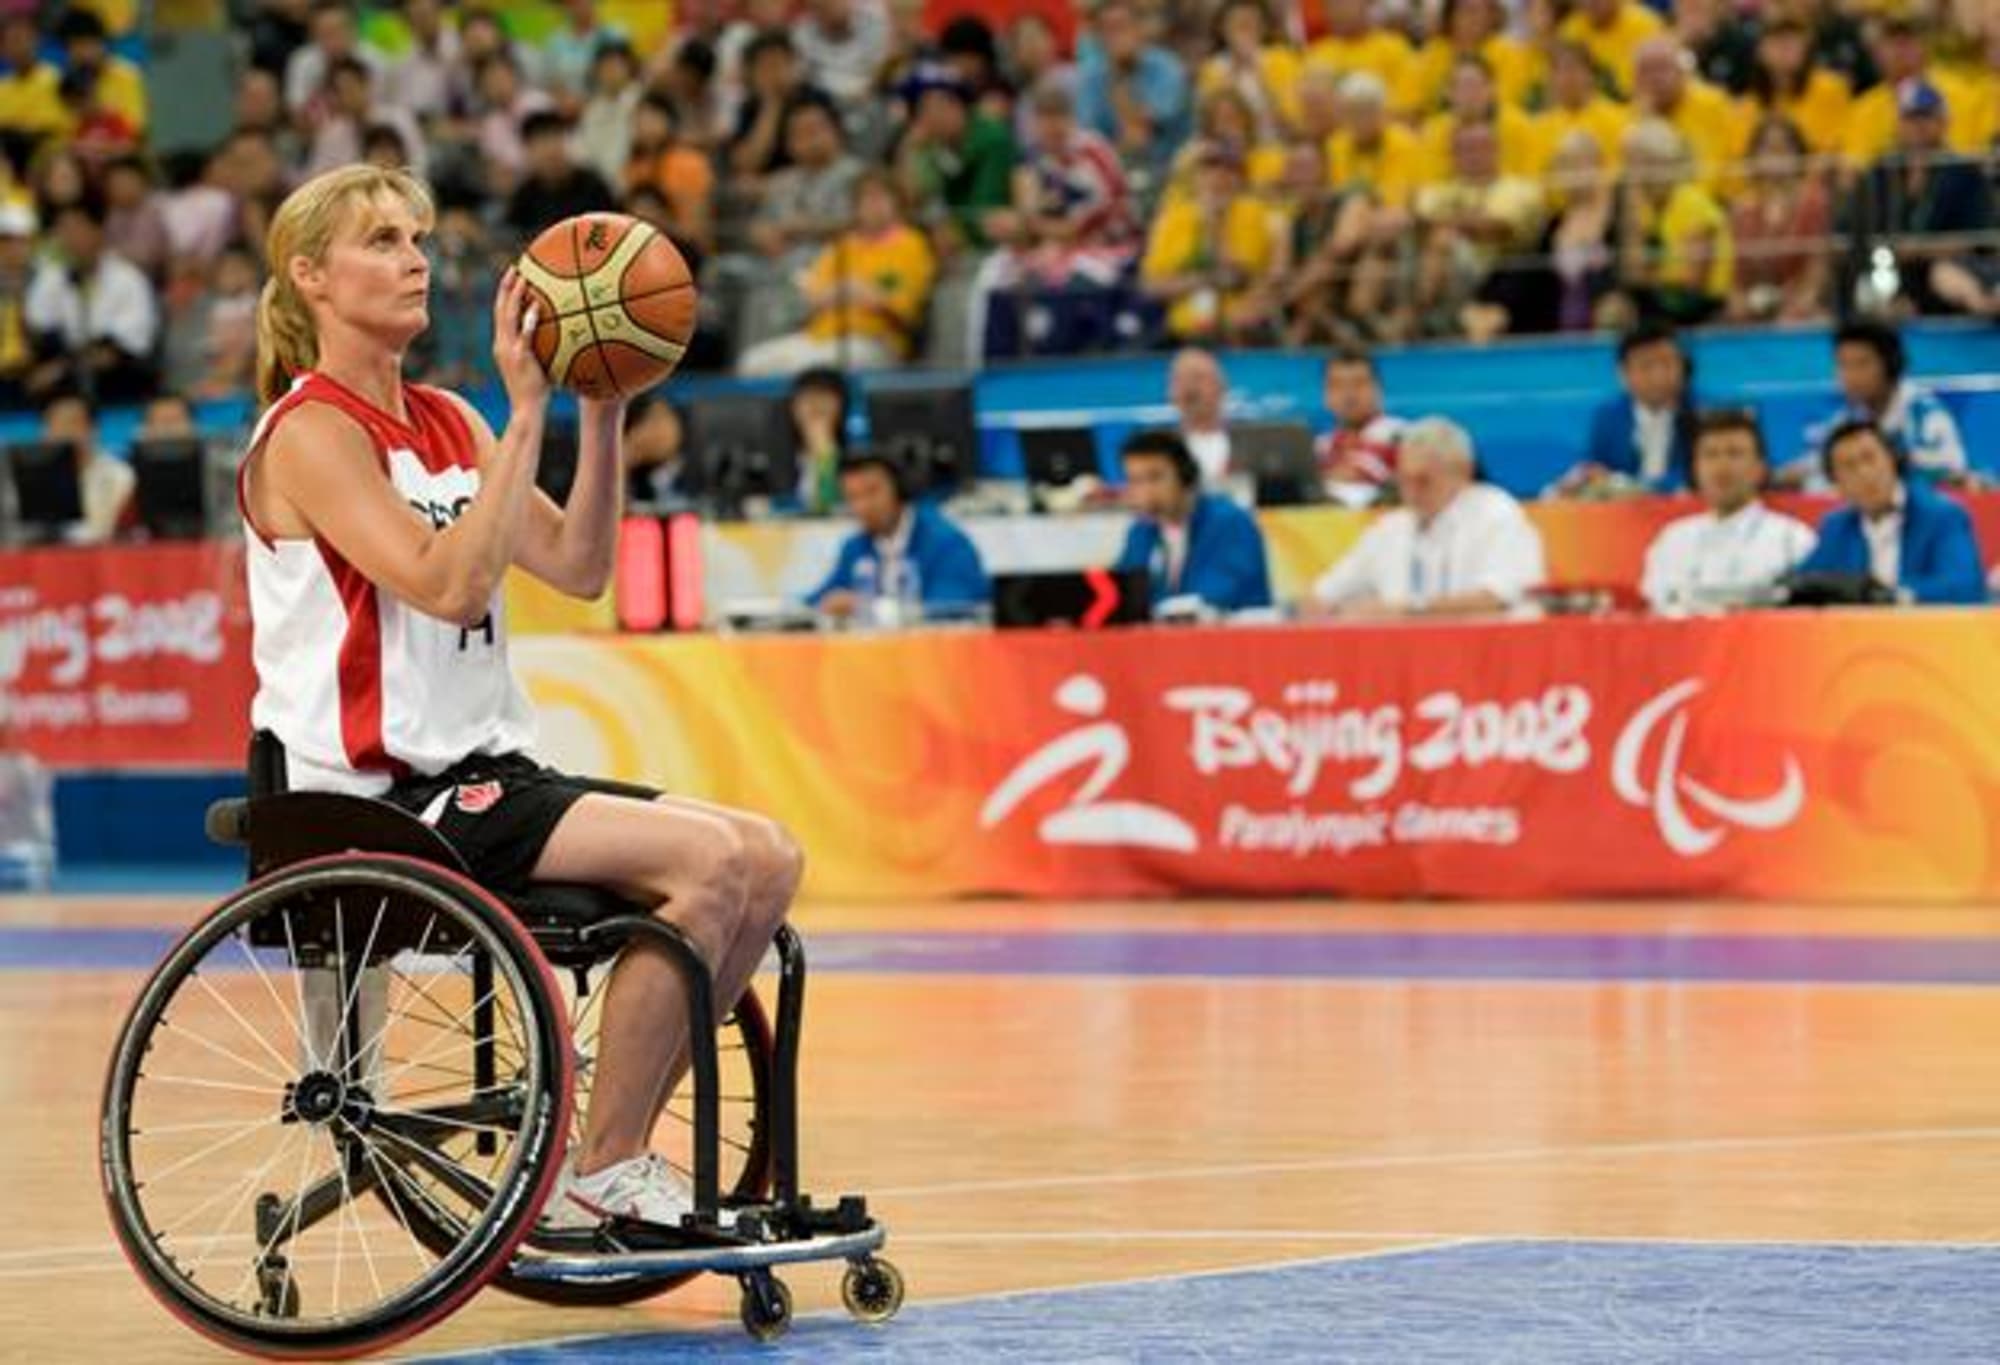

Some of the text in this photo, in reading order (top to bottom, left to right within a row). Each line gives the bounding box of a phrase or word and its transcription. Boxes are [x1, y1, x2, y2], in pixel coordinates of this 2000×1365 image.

[94, 590, 223, 663] 2008
[1163, 679, 1590, 799] Beijing 2008
[1219, 802, 1520, 856] Paralympic Games
